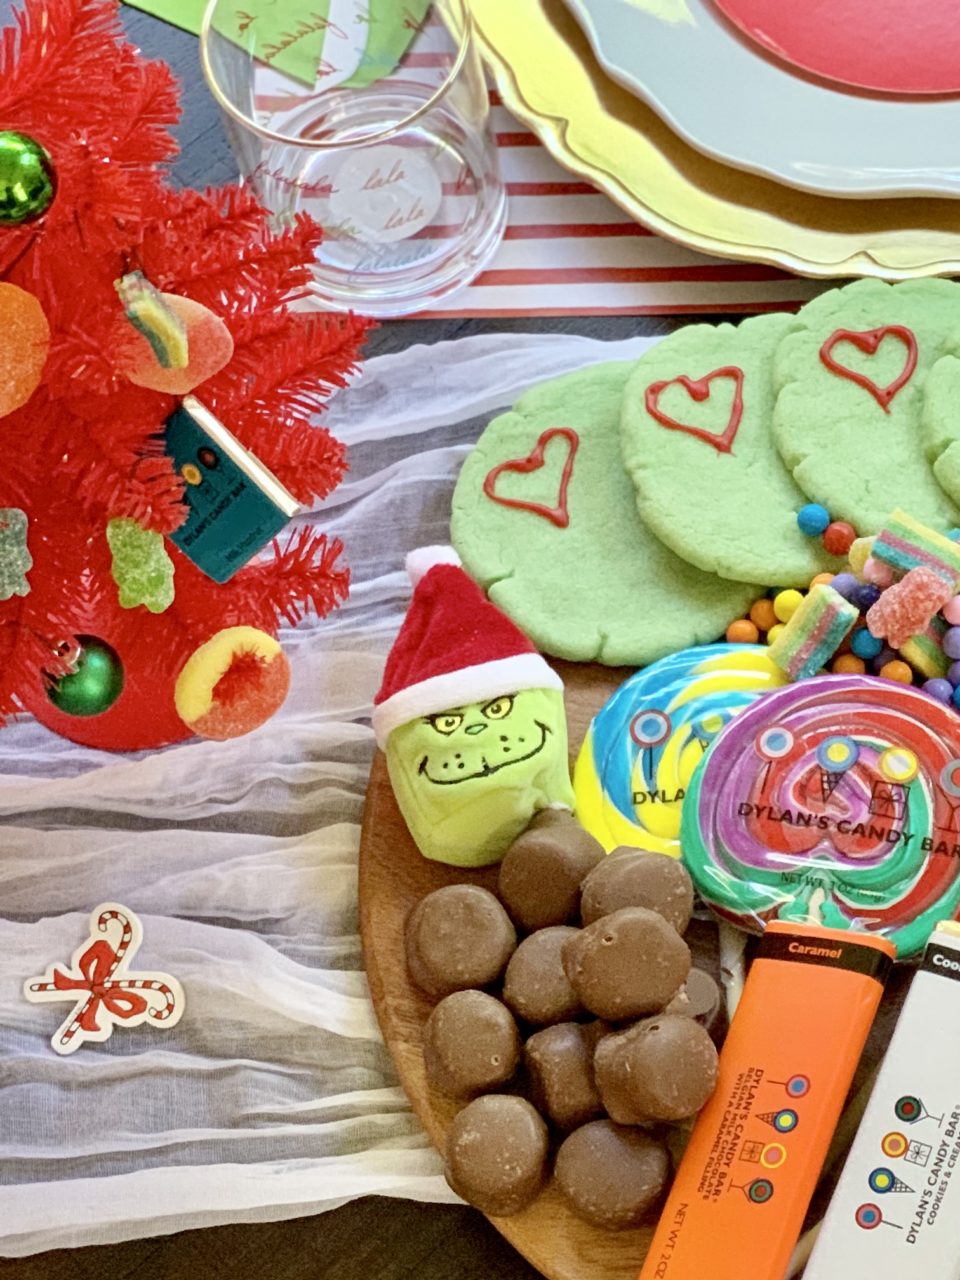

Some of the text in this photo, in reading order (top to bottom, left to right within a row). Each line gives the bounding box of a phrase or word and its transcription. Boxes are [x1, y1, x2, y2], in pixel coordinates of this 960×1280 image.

[361, 160, 406, 190] lala
[379, 197, 425, 231] lala
[633, 788, 685, 805] DYLA
[738, 801, 829, 831] DYLAN'S
[834, 818, 914, 847] CANDY
[788, 942, 842, 959] Caramel
[731, 1073, 745, 1099] WITH
[702, 1068, 755, 1200] BELGIAN MILK CHOCOLATE
[710, 1110, 731, 1155] CARAMEL
[712, 1069, 764, 1197] DYLAN'S CANDY BAR
[697, 1156, 715, 1193] FILLING
[906, 1189, 933, 1245] DYLAN'S
[927, 1139, 950, 1187] CANDY
[674, 1202, 689, 1227] NET
[927, 1180, 948, 1226] COOKIES
[943, 1171, 952, 1179] &
